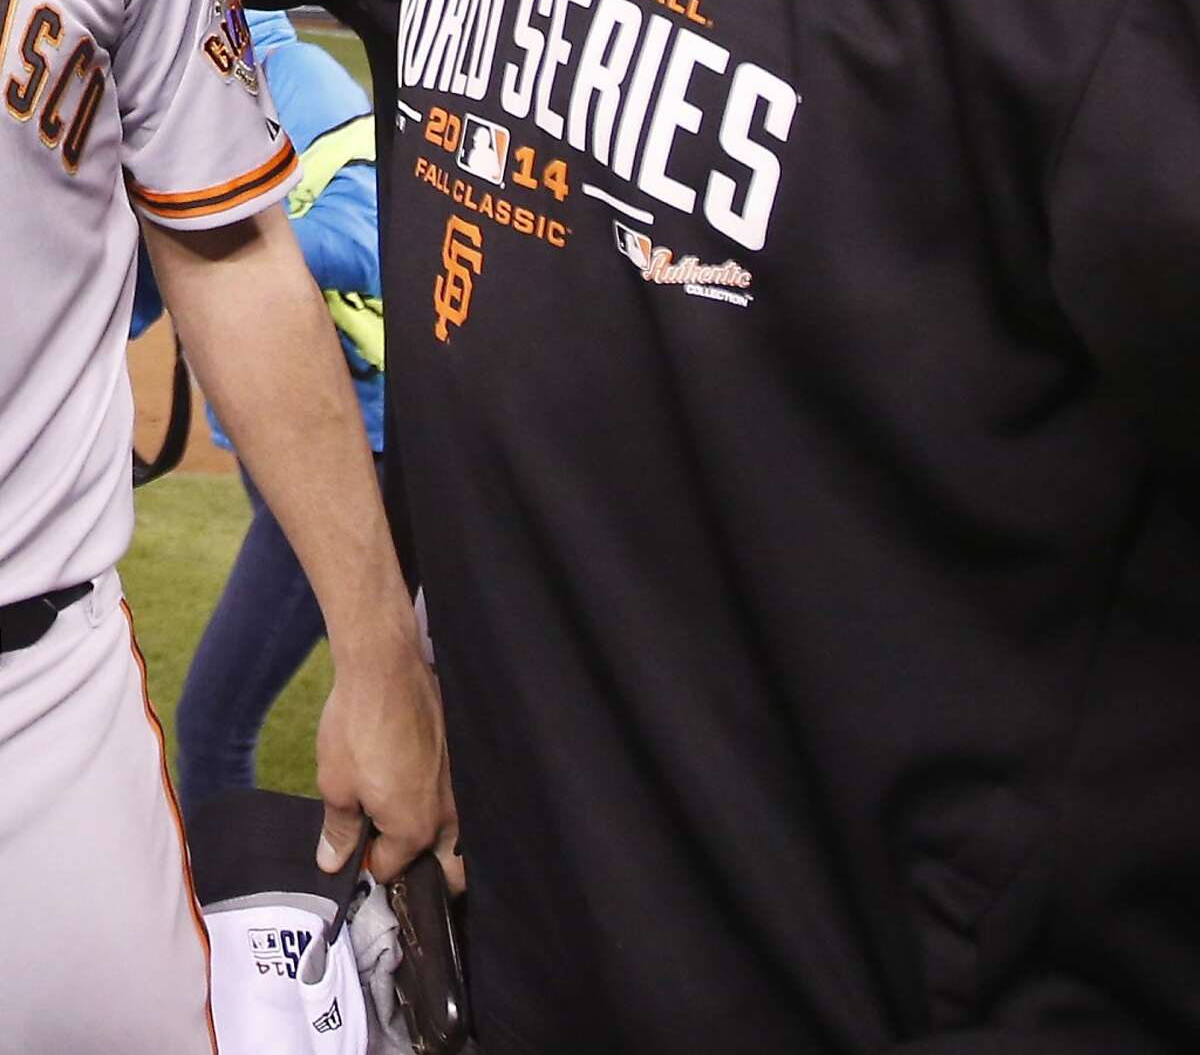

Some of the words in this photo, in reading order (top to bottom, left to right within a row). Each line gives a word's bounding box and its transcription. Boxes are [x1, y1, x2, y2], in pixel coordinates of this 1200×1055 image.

[414, 157, 451, 195] FALL
[452, 179, 567, 248] CLASSIC
[512, 146, 570, 203] 14
